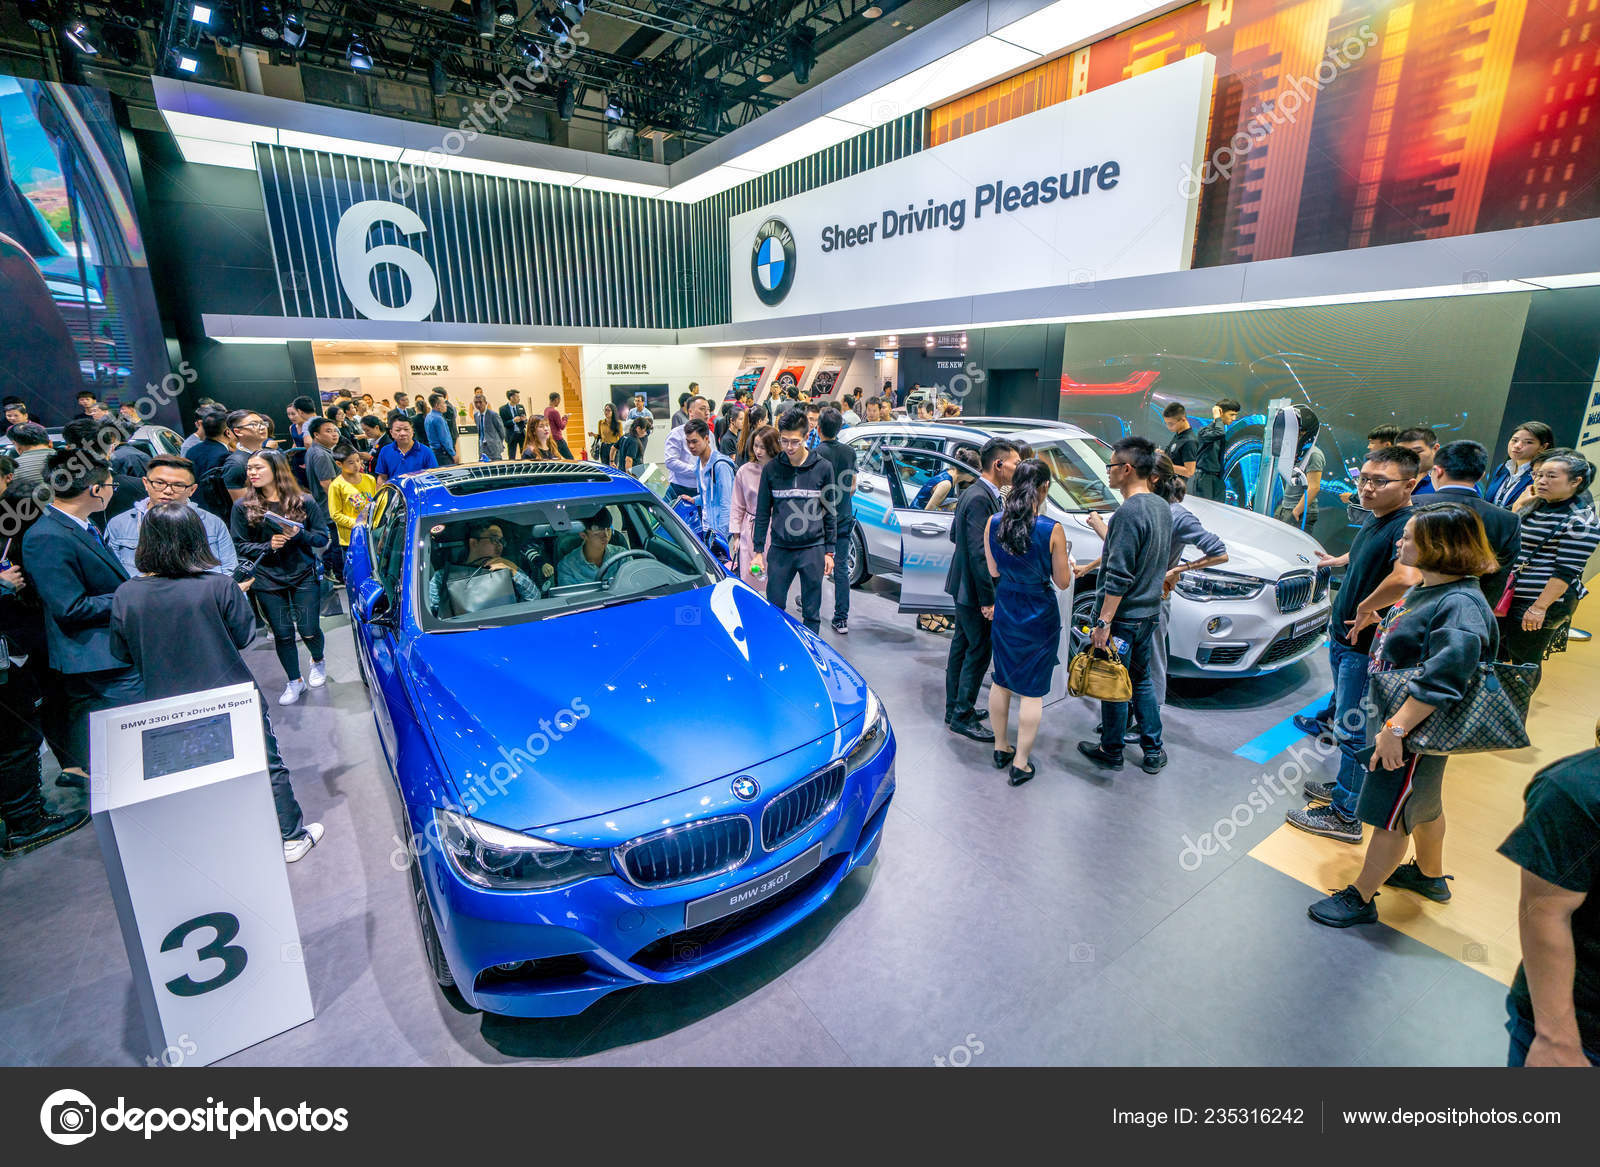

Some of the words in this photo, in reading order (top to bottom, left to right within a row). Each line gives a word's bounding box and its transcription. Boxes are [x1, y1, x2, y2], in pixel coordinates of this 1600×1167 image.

[821, 222, 877, 252] Sheer
[881, 199, 966, 239] Driving
[974, 160, 1121, 218] Pleasure
[752, 220, 793, 254] BMW
[335, 200, 438, 321] 6
[937, 361, 949, 369] THE
[120, 719, 147, 731] BMW
[149, 714, 170, 725] 330i
[171, 711, 185, 720] GT
[187, 705, 216, 717] xDrive
[218, 702, 226, 710] M
[227, 698, 253, 708] Sport
[729, 887, 759, 905] BMW
[160, 912, 248, 997] 3
